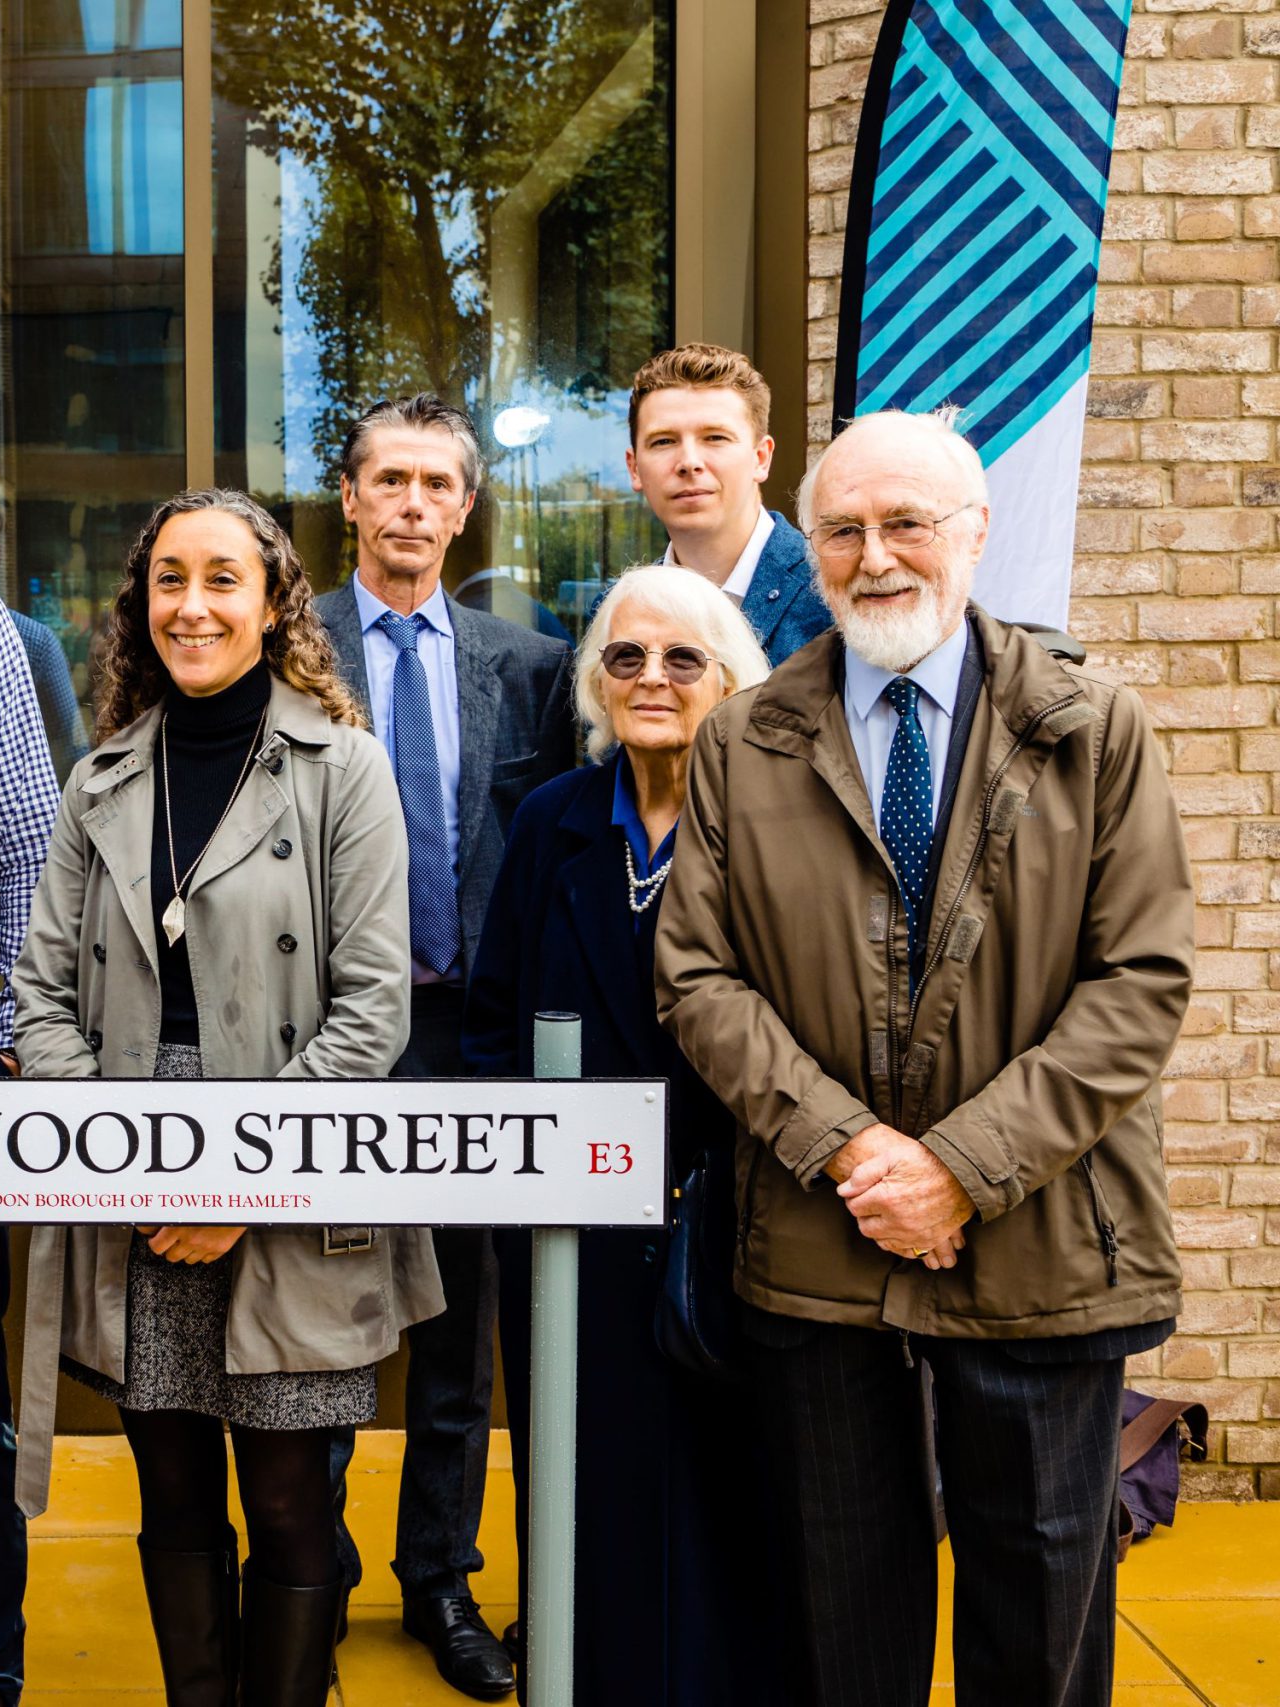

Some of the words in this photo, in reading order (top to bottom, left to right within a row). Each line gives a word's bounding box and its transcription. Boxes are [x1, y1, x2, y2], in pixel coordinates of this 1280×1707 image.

[234, 1111, 558, 1175] STREET
[588, 1141, 634, 1175] E3
[35, 1193, 125, 1208] BOROUGH
[130, 1194, 153, 1208] OF
[158, 1194, 223, 1208] TOWER
[228, 1194, 311, 1209] HAMLETS
